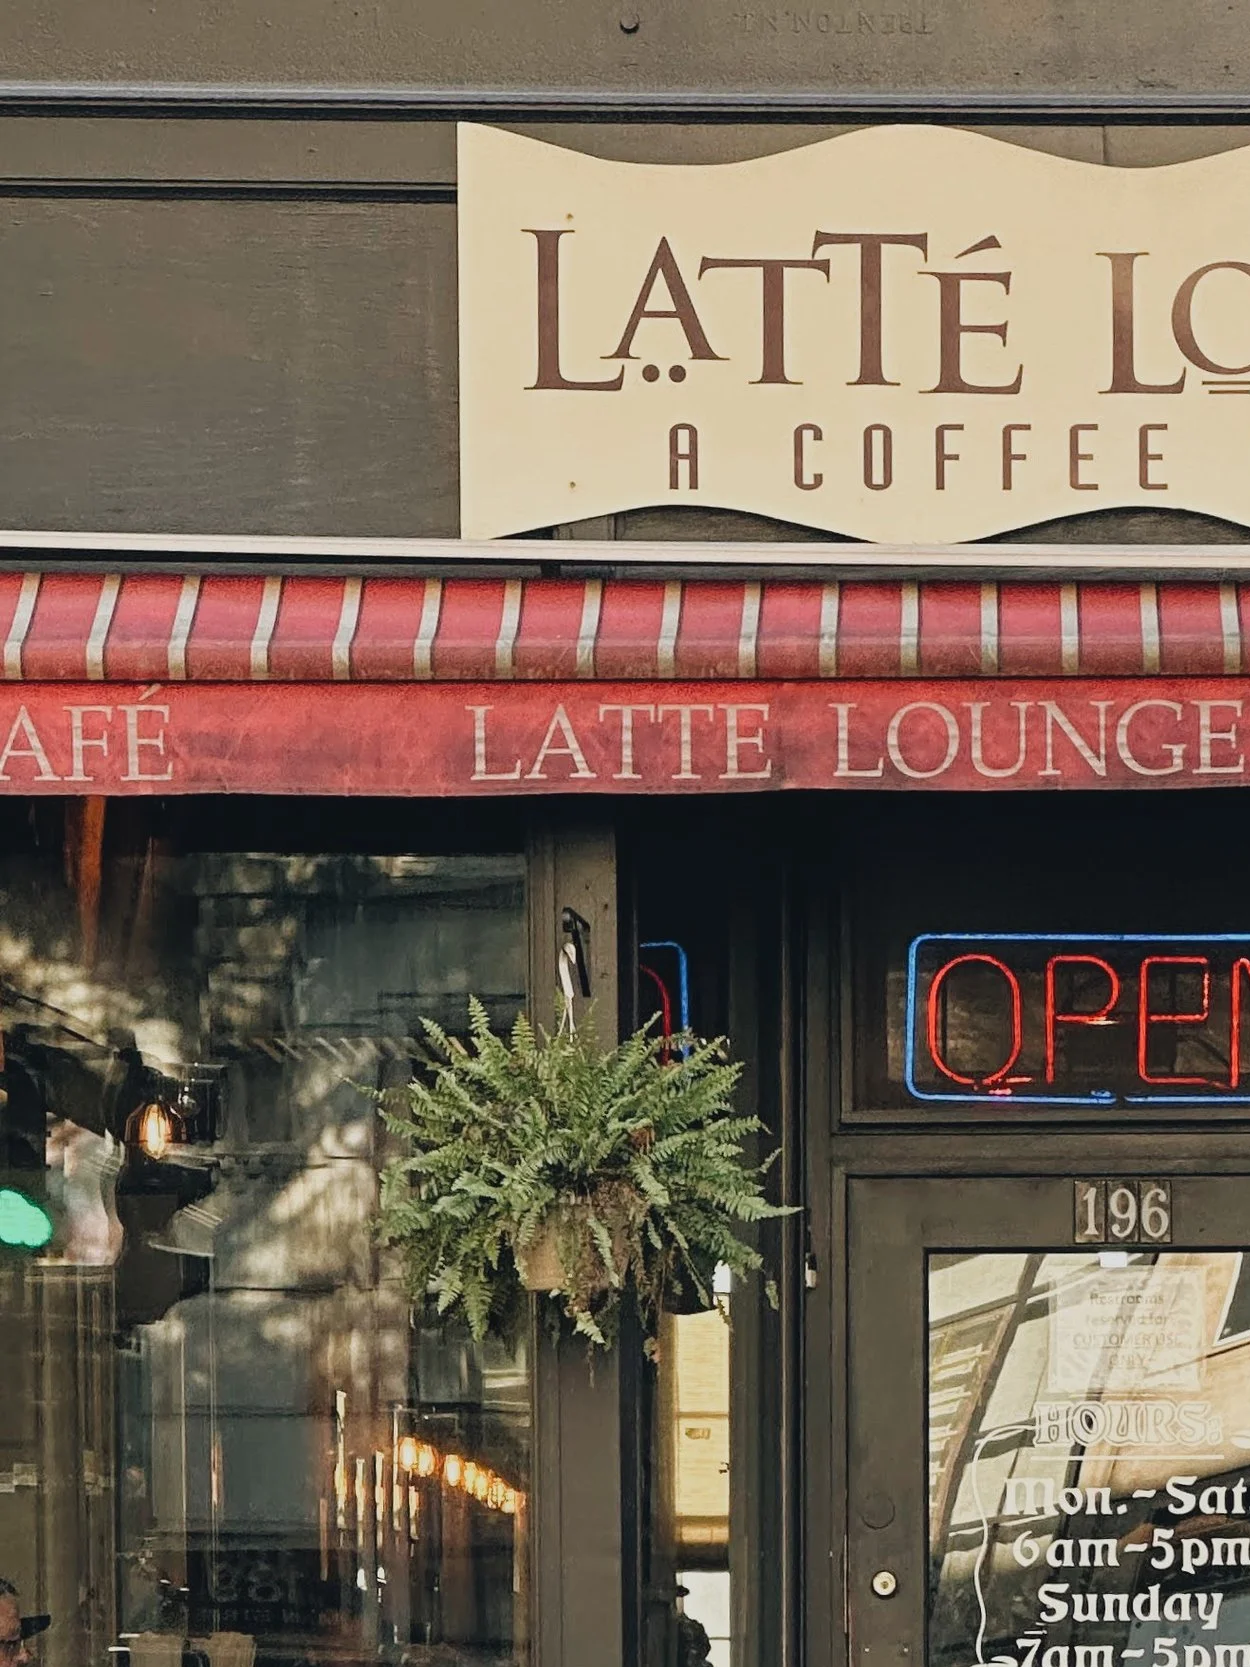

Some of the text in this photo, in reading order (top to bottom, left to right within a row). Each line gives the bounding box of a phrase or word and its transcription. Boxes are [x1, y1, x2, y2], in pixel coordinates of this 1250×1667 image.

[520, 227, 1023, 394] LATTÉ
[669, 423, 698, 490] A
[793, 423, 1168, 491] COFFEE
[465, 700, 1246, 781] LATTE LOUNGE
[1083, 1187, 1169, 1238] 196
[1037, 1583, 1223, 1630] Sunday
